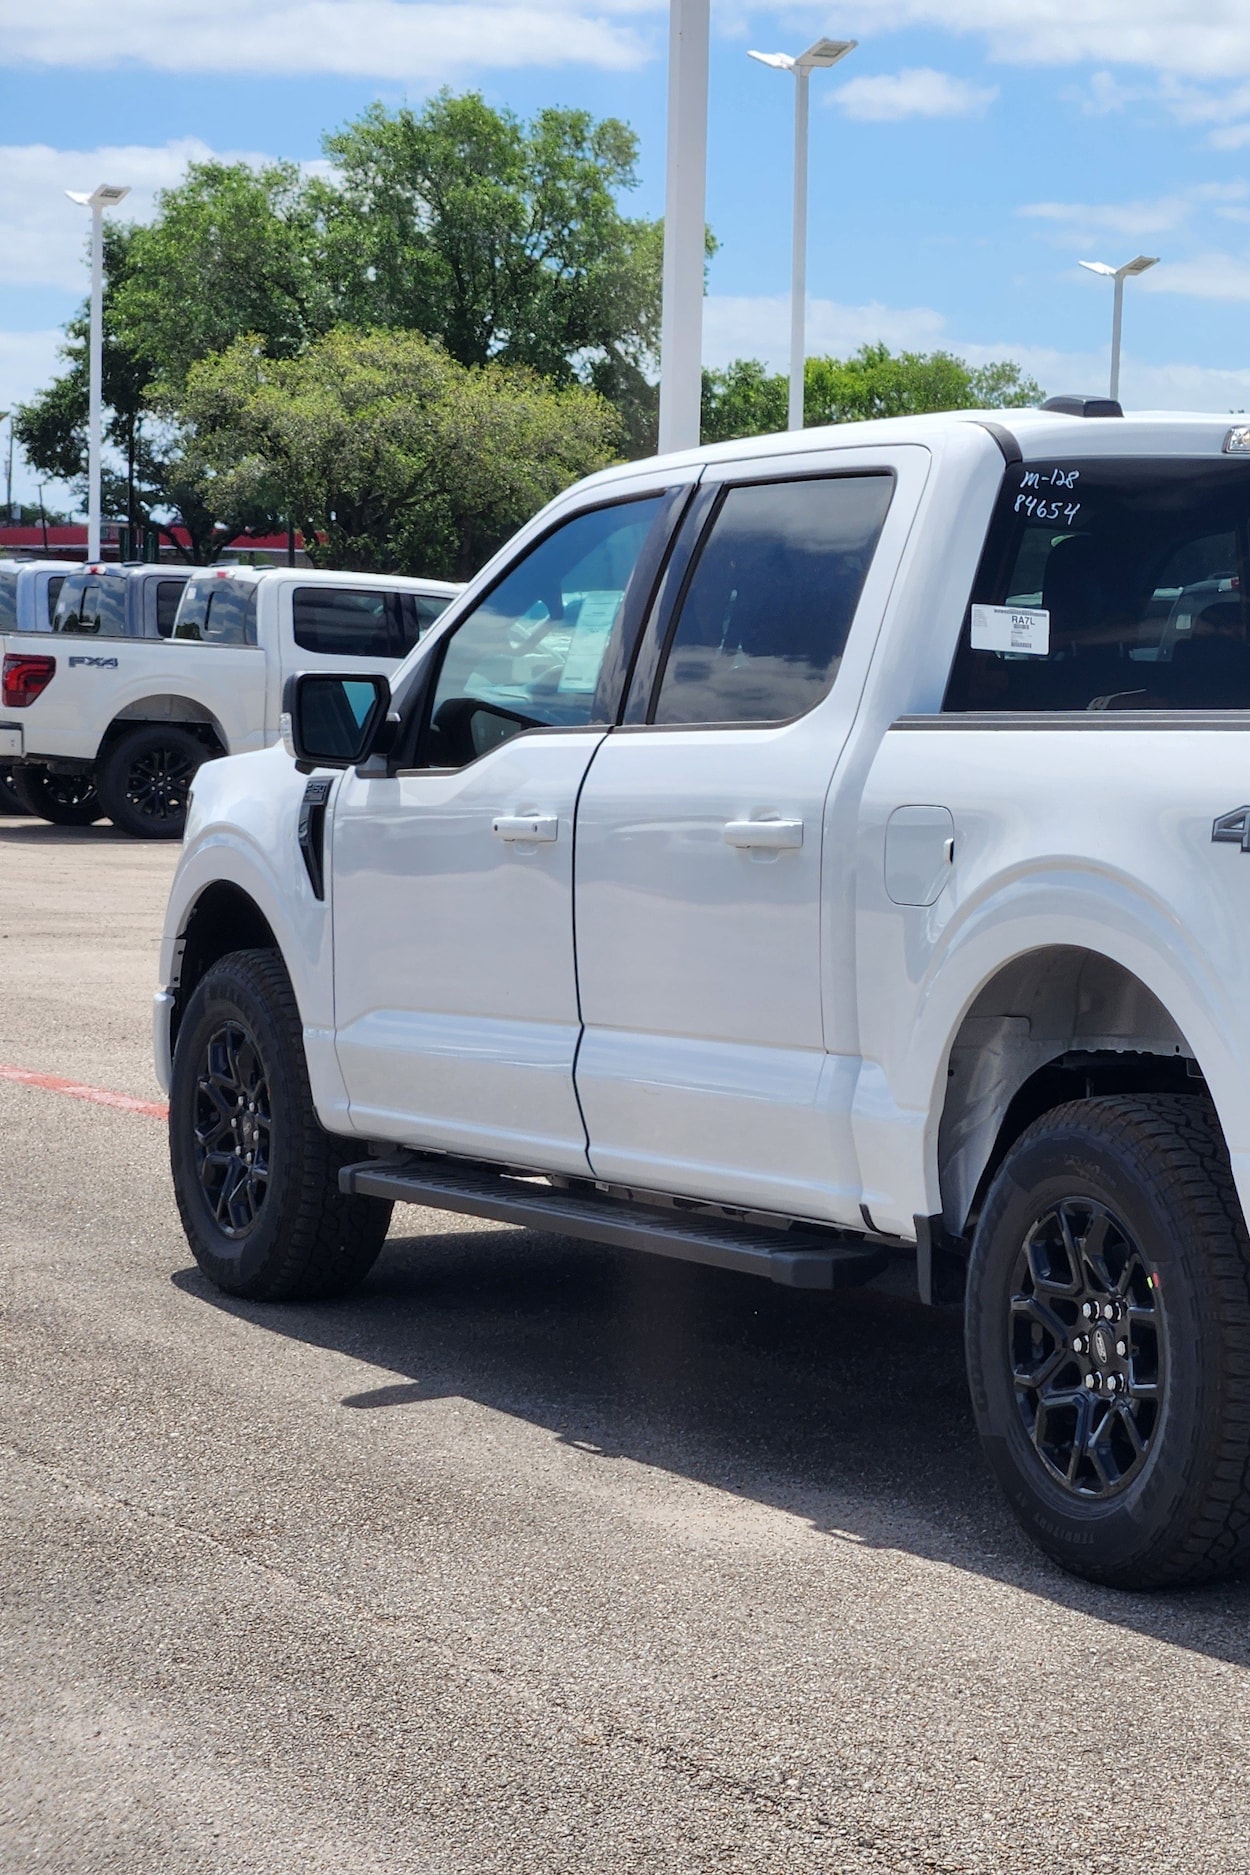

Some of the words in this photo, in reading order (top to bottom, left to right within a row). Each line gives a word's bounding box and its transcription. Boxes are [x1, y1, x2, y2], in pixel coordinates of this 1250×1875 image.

[1014, 494, 1080, 525] 84654
[1011, 615, 1036, 626] RA7L
[68, 656, 118, 668] FX4
